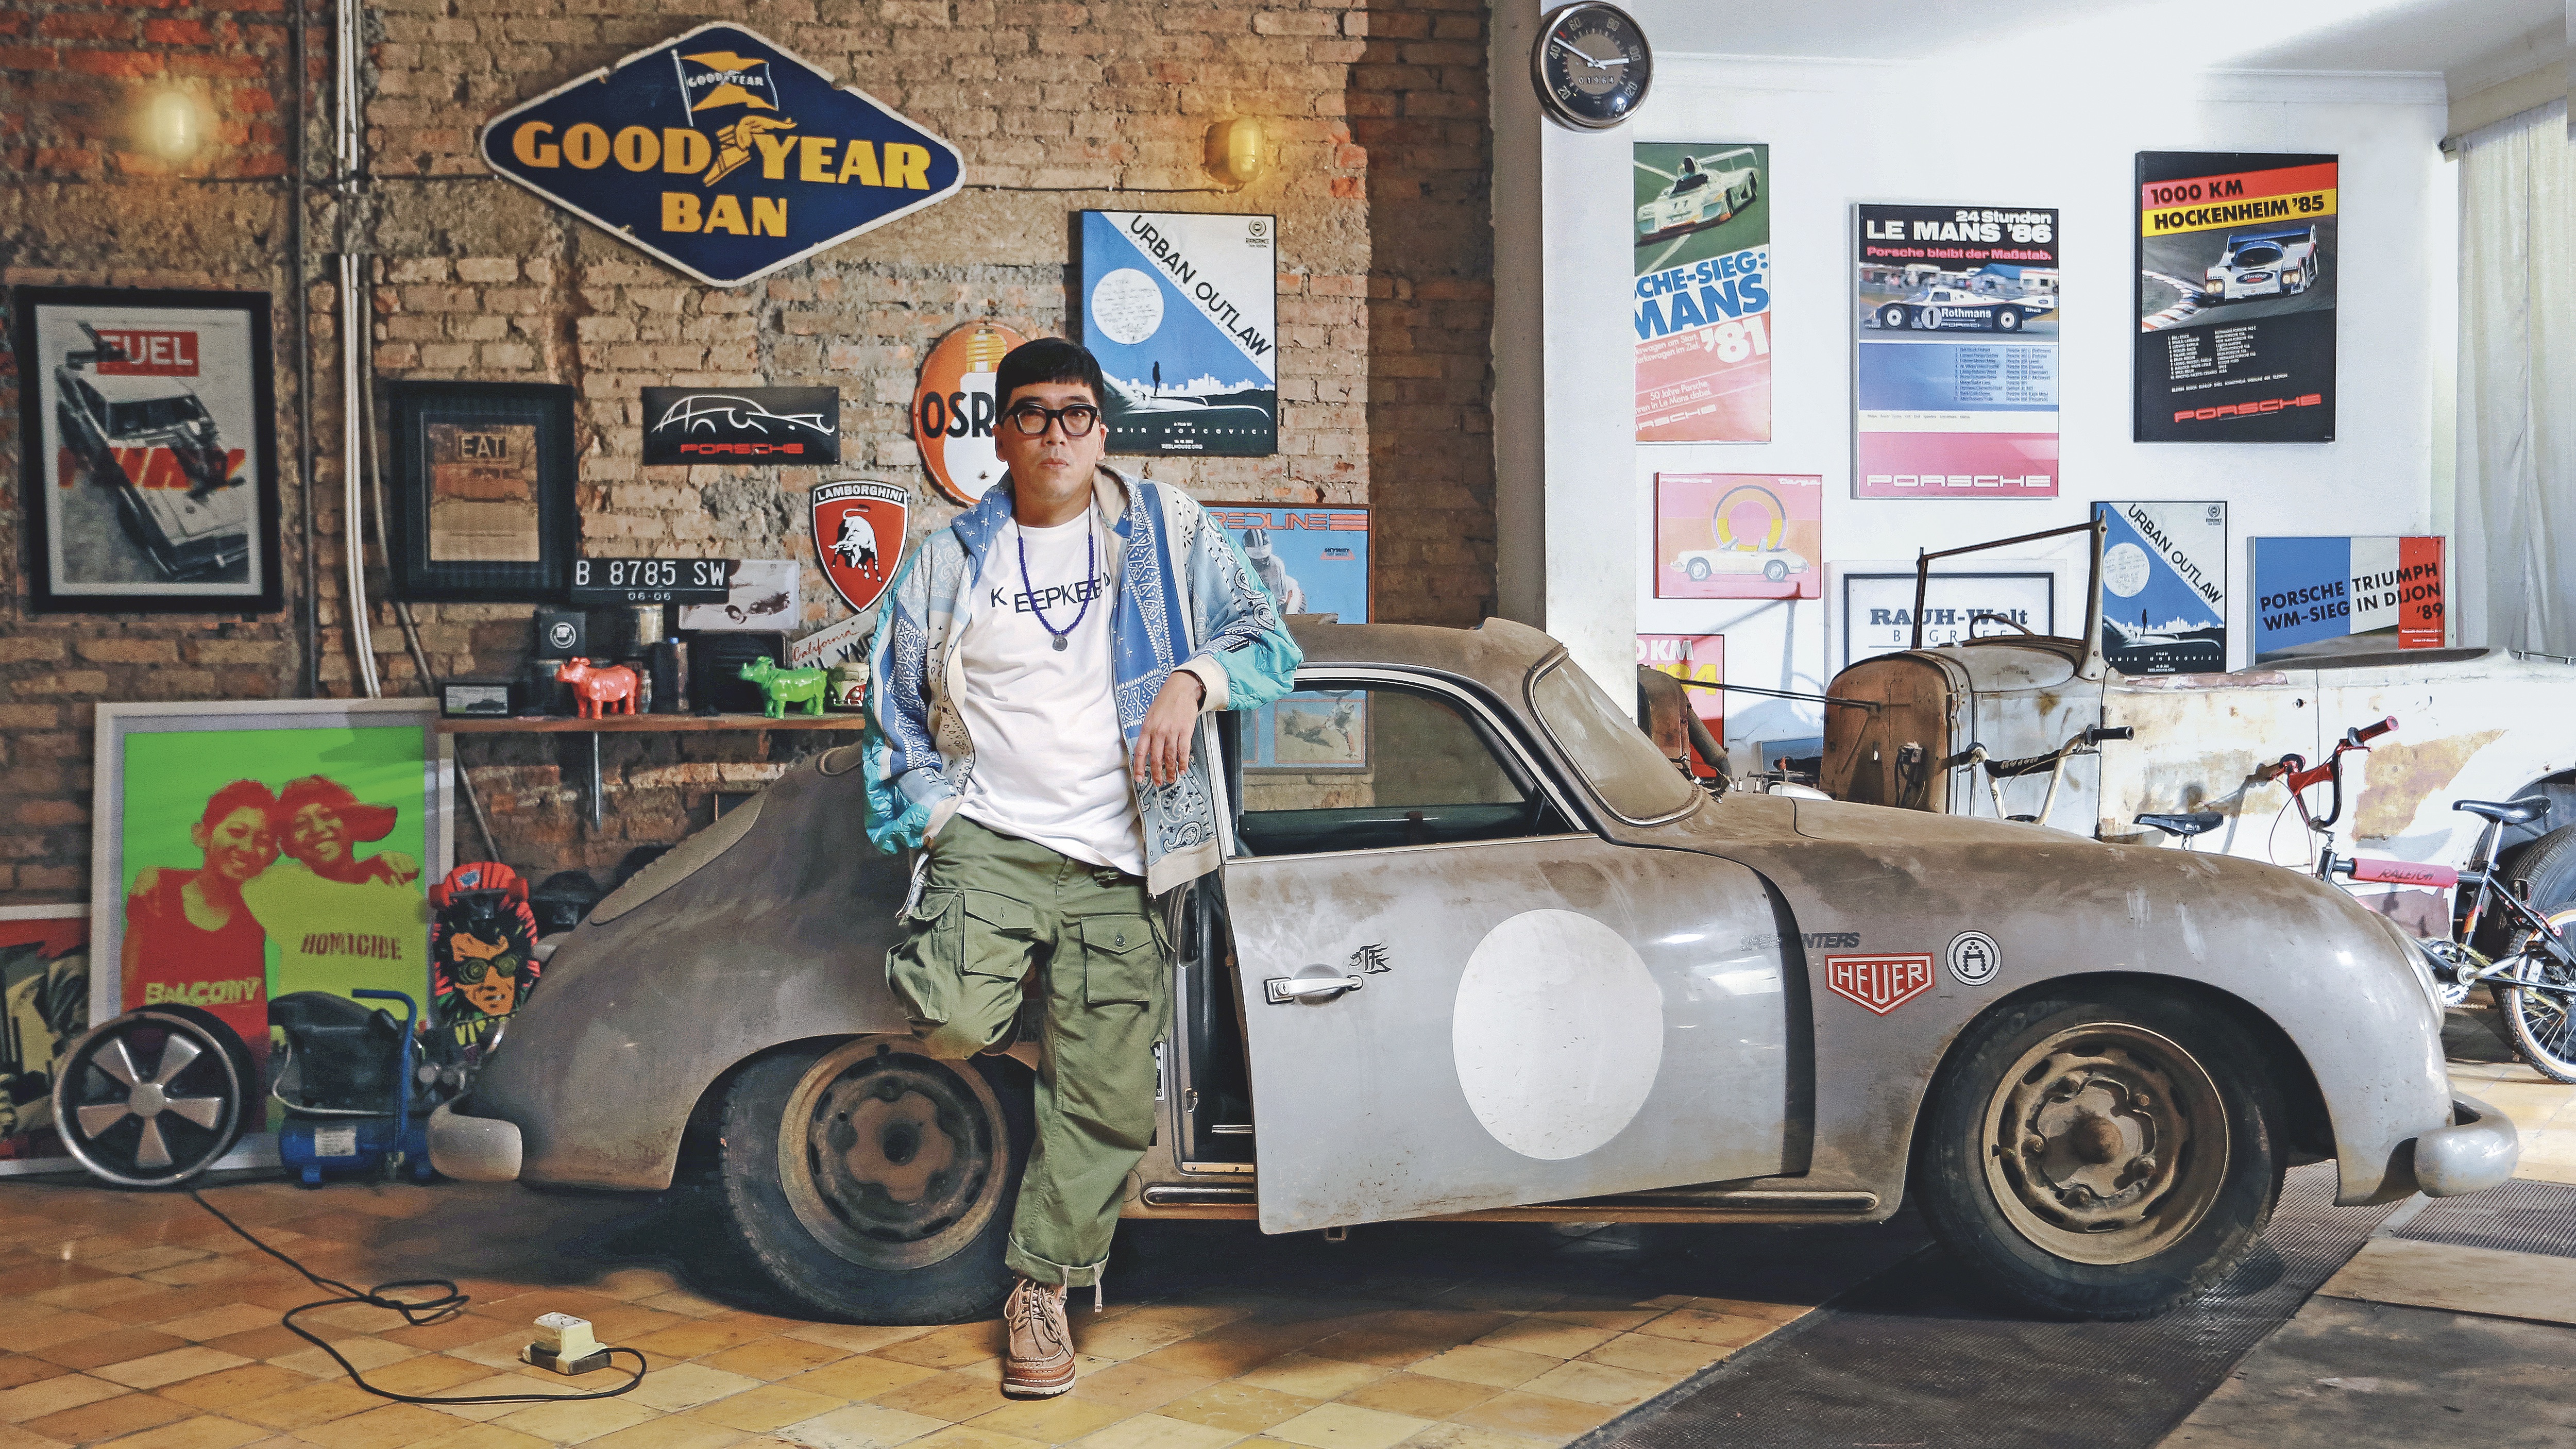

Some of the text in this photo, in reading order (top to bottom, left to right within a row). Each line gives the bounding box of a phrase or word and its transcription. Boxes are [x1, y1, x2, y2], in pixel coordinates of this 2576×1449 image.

[513, 121, 931, 190] GOOD YEAR
[2151, 179, 2243, 205] 1000 KM
[662, 192, 787, 237] BAN
[1956, 210, 2052, 224] 24 Stunden
[2154, 195, 2324, 230] HOCKENHEIM '85
[1867, 220, 1905, 240] LE
[1913, 221, 2001, 242] MANS
[1867, 246, 1925, 258] Porsche
[1965, 248, 1989, 259] der
[1130, 215, 1196, 284] URBAN
[1196, 282, 1273, 356] OUTLAW
[1634, 251, 1768, 300] CHE-SIEG:
[1634, 274, 1769, 340] MANS
[1941, 308, 1992, 318] Rothmans
[921, 392, 995, 438] OSR
[2174, 393, 2322, 423] PORSCHE
[461, 434, 504, 458] EAT
[680, 443, 804, 454] PORSCHE
[817, 485, 904, 501] LAMBORGHINI
[1867, 475, 2052, 487] PORSCHE
[2128, 503, 2223, 603] URBAN OUTLAW
[575, 560, 725, 586] B 8785 SW
[2259, 562, 2438, 613] PORSCHE TRIUMPH
[2263, 582, 2441, 632] WM-SIEG IN DIJON
[792, 630, 859, 662] California
[1837, 963, 1924, 1004] HEUER
